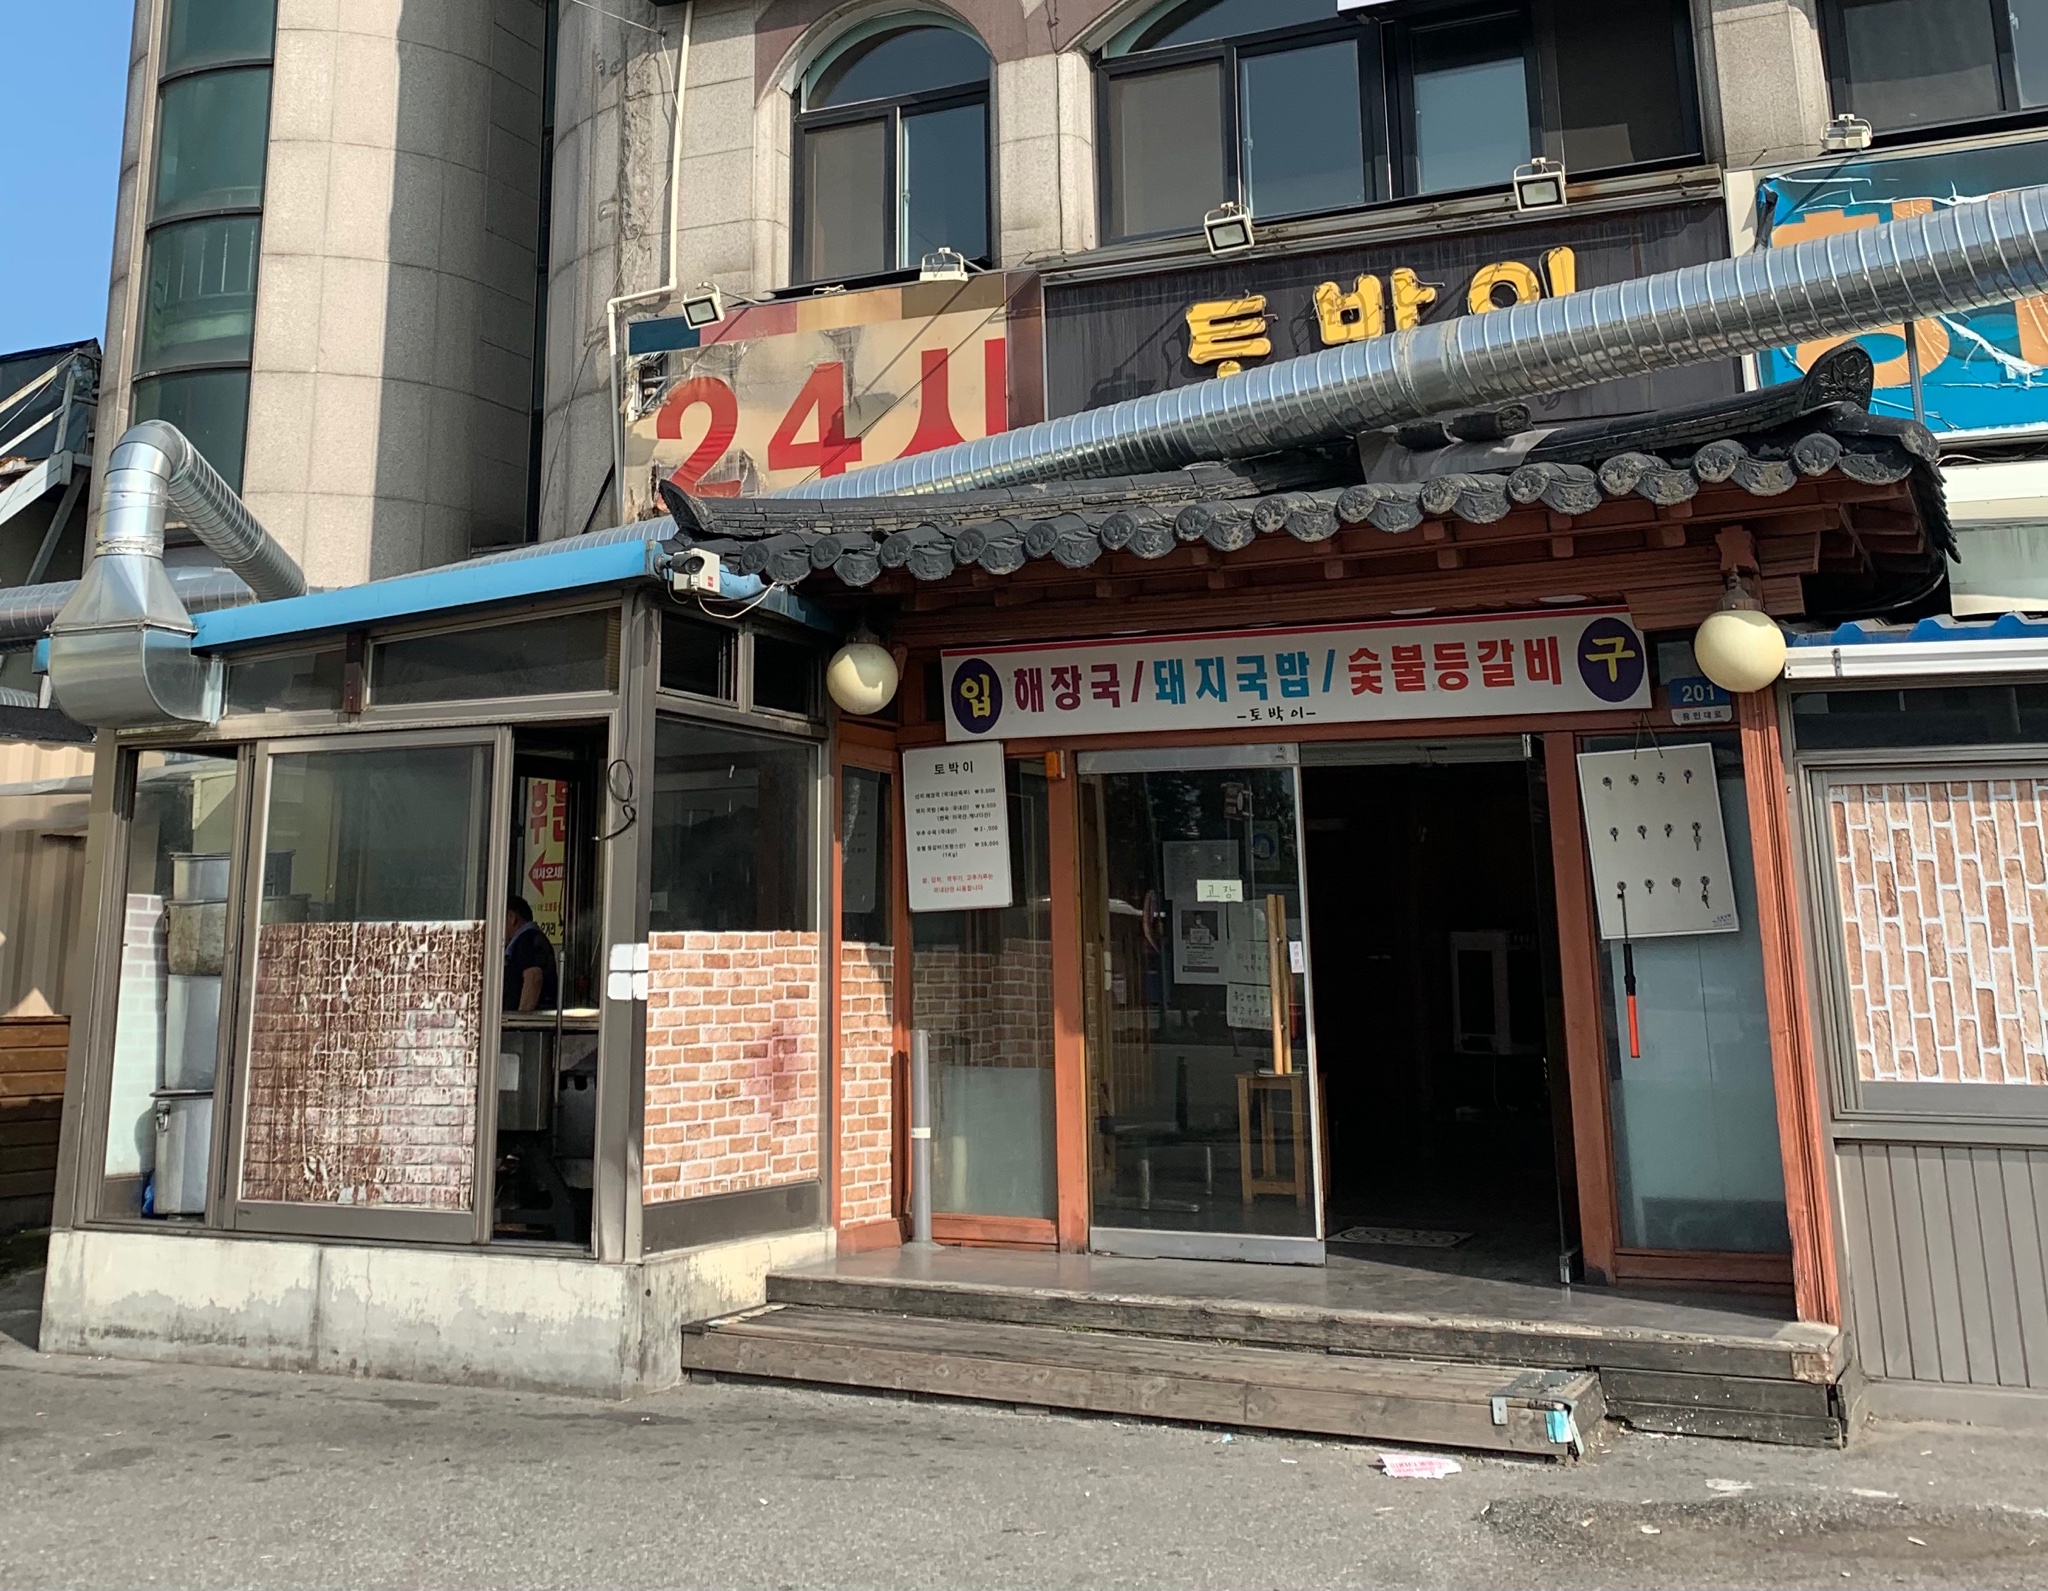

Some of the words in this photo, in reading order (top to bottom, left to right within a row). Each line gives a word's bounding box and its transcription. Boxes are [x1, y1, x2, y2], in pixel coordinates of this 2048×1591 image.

[960, 673, 992, 719] 입
[1585, 636, 1636, 682] 구
[1681, 684, 1716, 703] 201
[934, 760, 974, 776] 토박이
[1206, 884, 1237, 900] 고장
